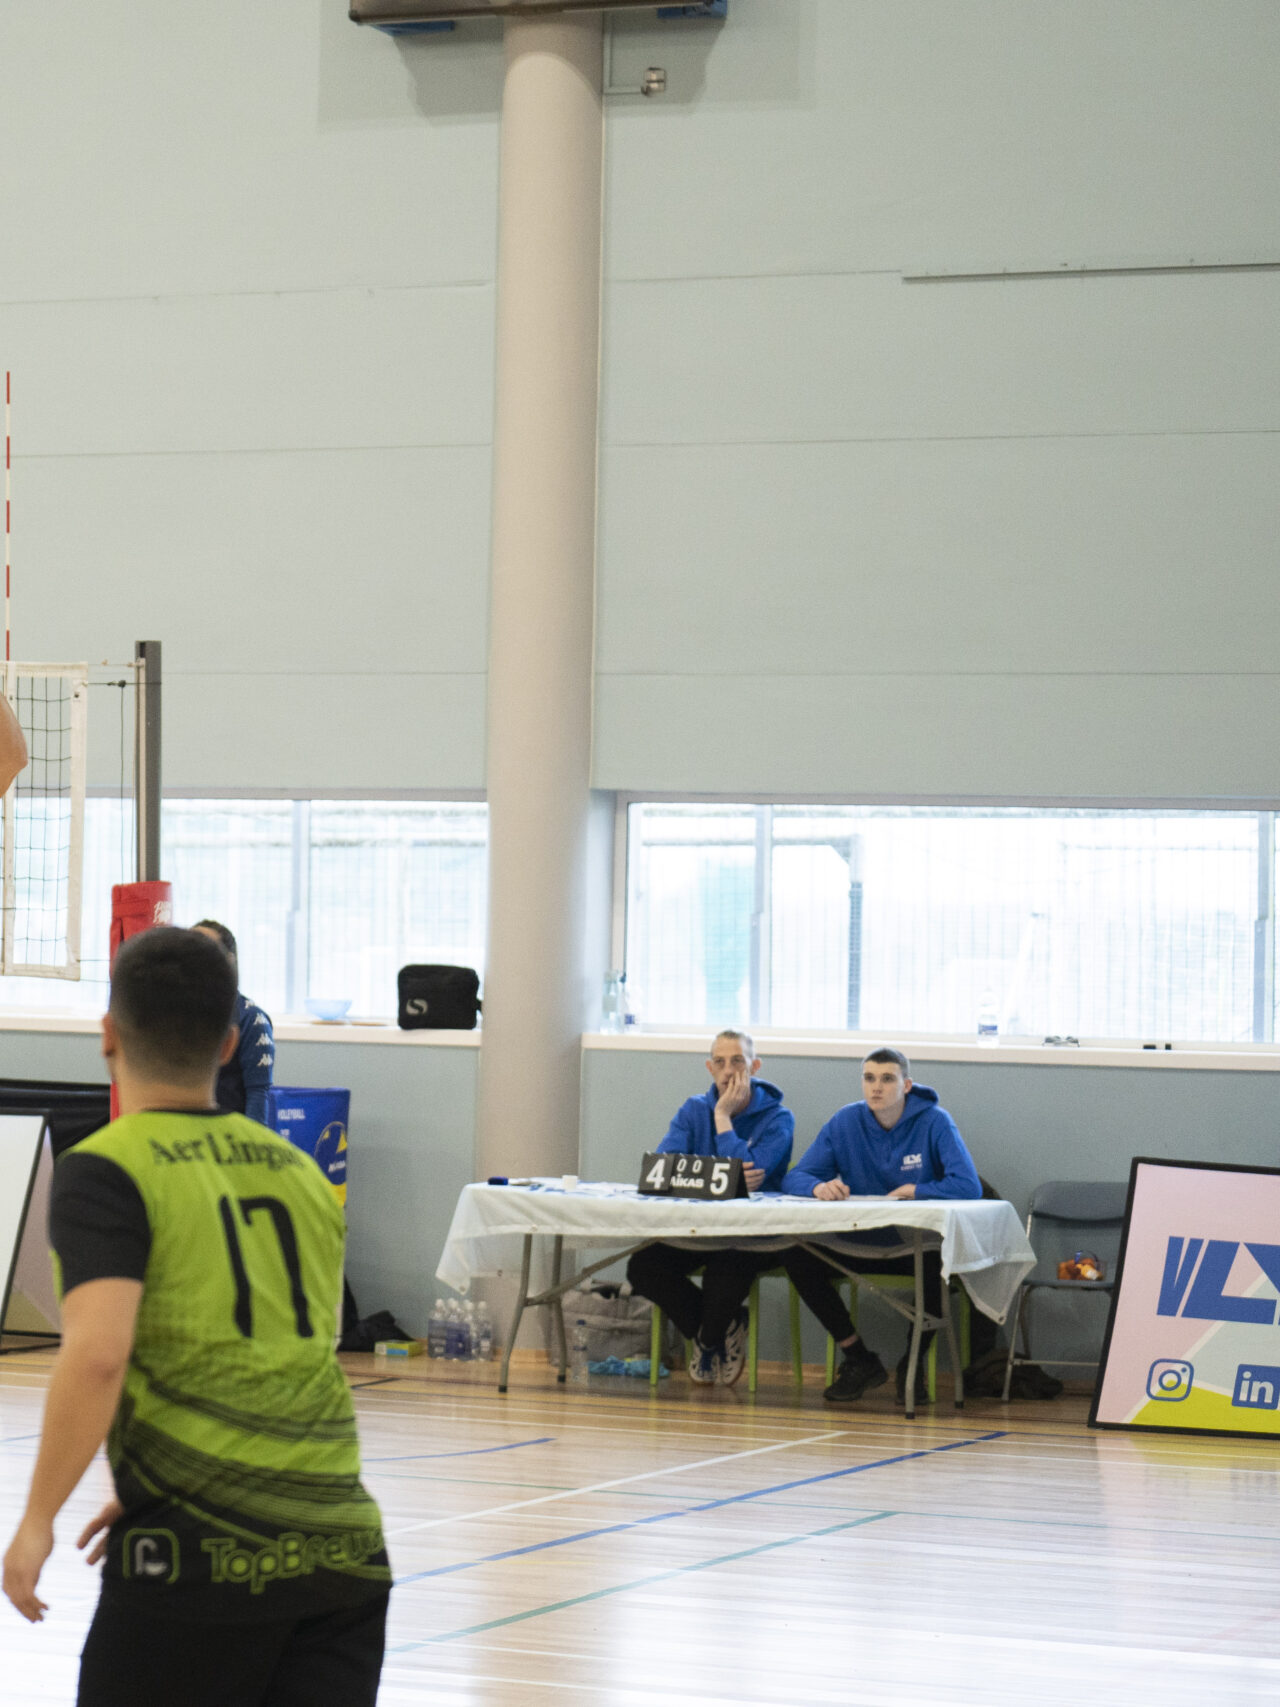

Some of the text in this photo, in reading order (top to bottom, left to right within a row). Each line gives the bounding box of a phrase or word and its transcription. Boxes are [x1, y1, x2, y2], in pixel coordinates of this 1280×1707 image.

[148, 1132, 206, 1165] Aer
[646, 1158, 666, 1190] 4
[709, 1162, 731, 1195] 5
[219, 1194, 315, 1338] 17
